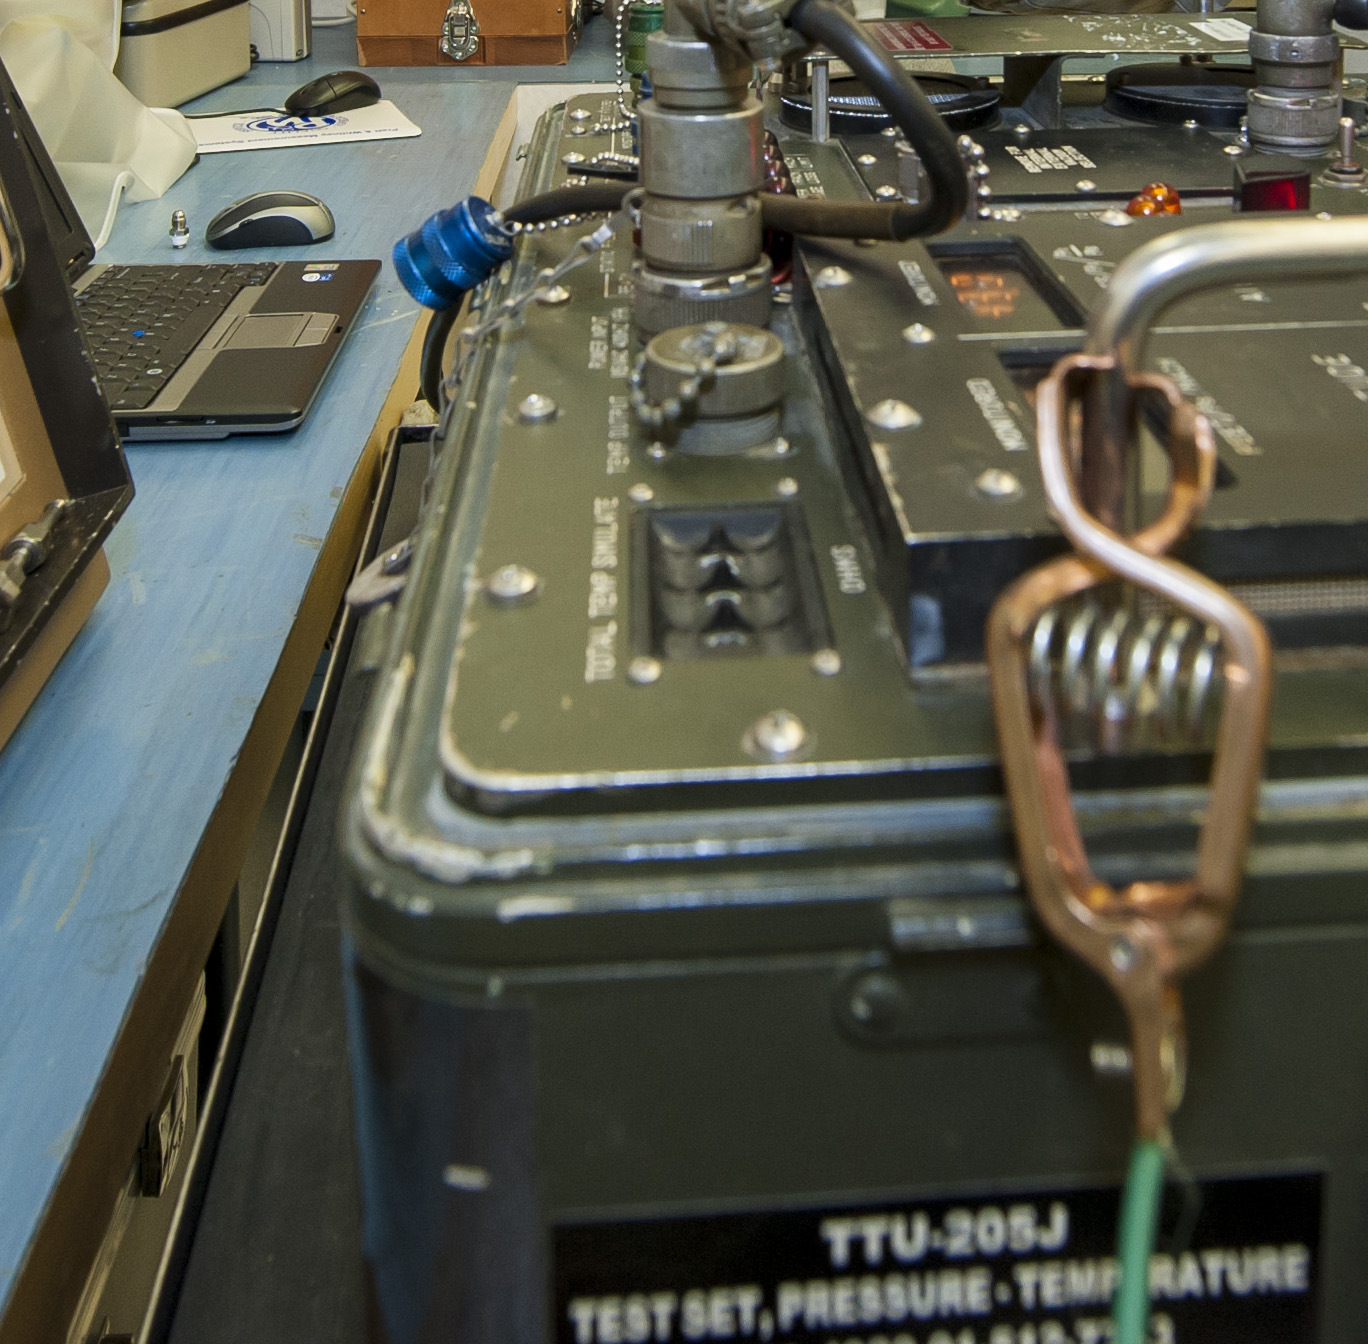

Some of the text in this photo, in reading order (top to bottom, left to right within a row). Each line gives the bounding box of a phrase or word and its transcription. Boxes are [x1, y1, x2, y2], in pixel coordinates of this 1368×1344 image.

[588, 570, 618, 618] TEMP
[585, 619, 618, 683] TOTAL
[819, 1201, 1070, 1268] TTU-205J
[568, 1291, 678, 1344] TEST
[680, 1283, 775, 1343] SET,
